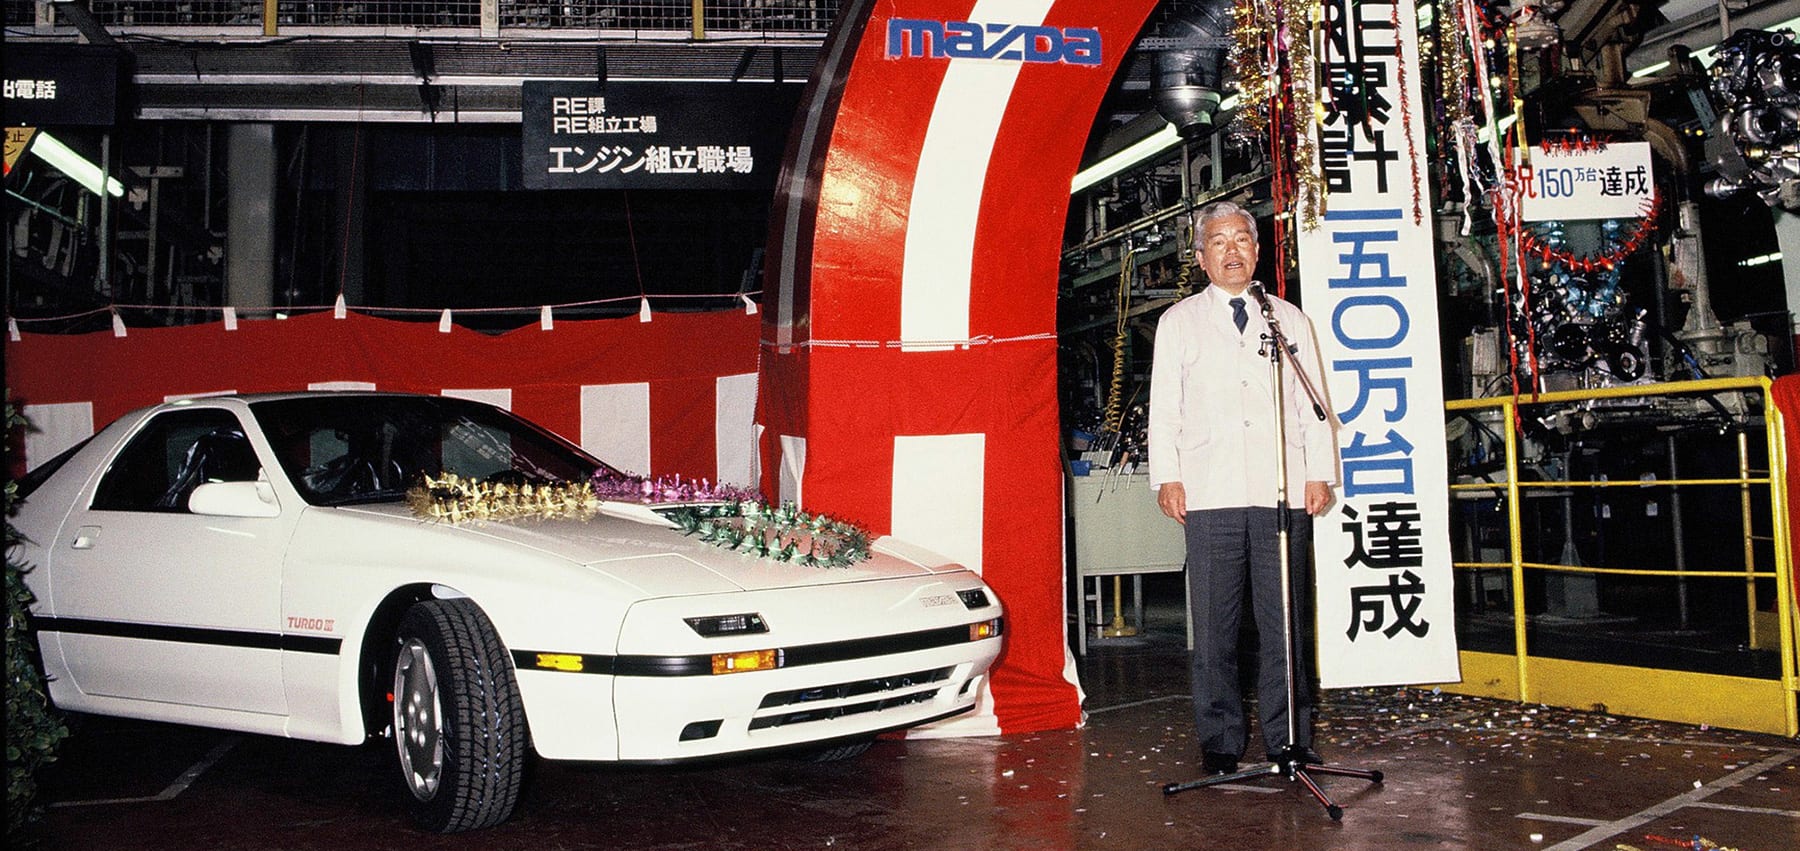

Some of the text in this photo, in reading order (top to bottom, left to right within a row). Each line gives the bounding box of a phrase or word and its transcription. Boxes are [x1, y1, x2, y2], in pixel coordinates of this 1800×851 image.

[886, 18, 1102, 66] mazda
[552, 97, 606, 114] RE課
[553, 115, 657, 134] RE組立工場
[548, 145, 753, 174] エンジン組立職場
[287, 616, 323, 631] TURBO
